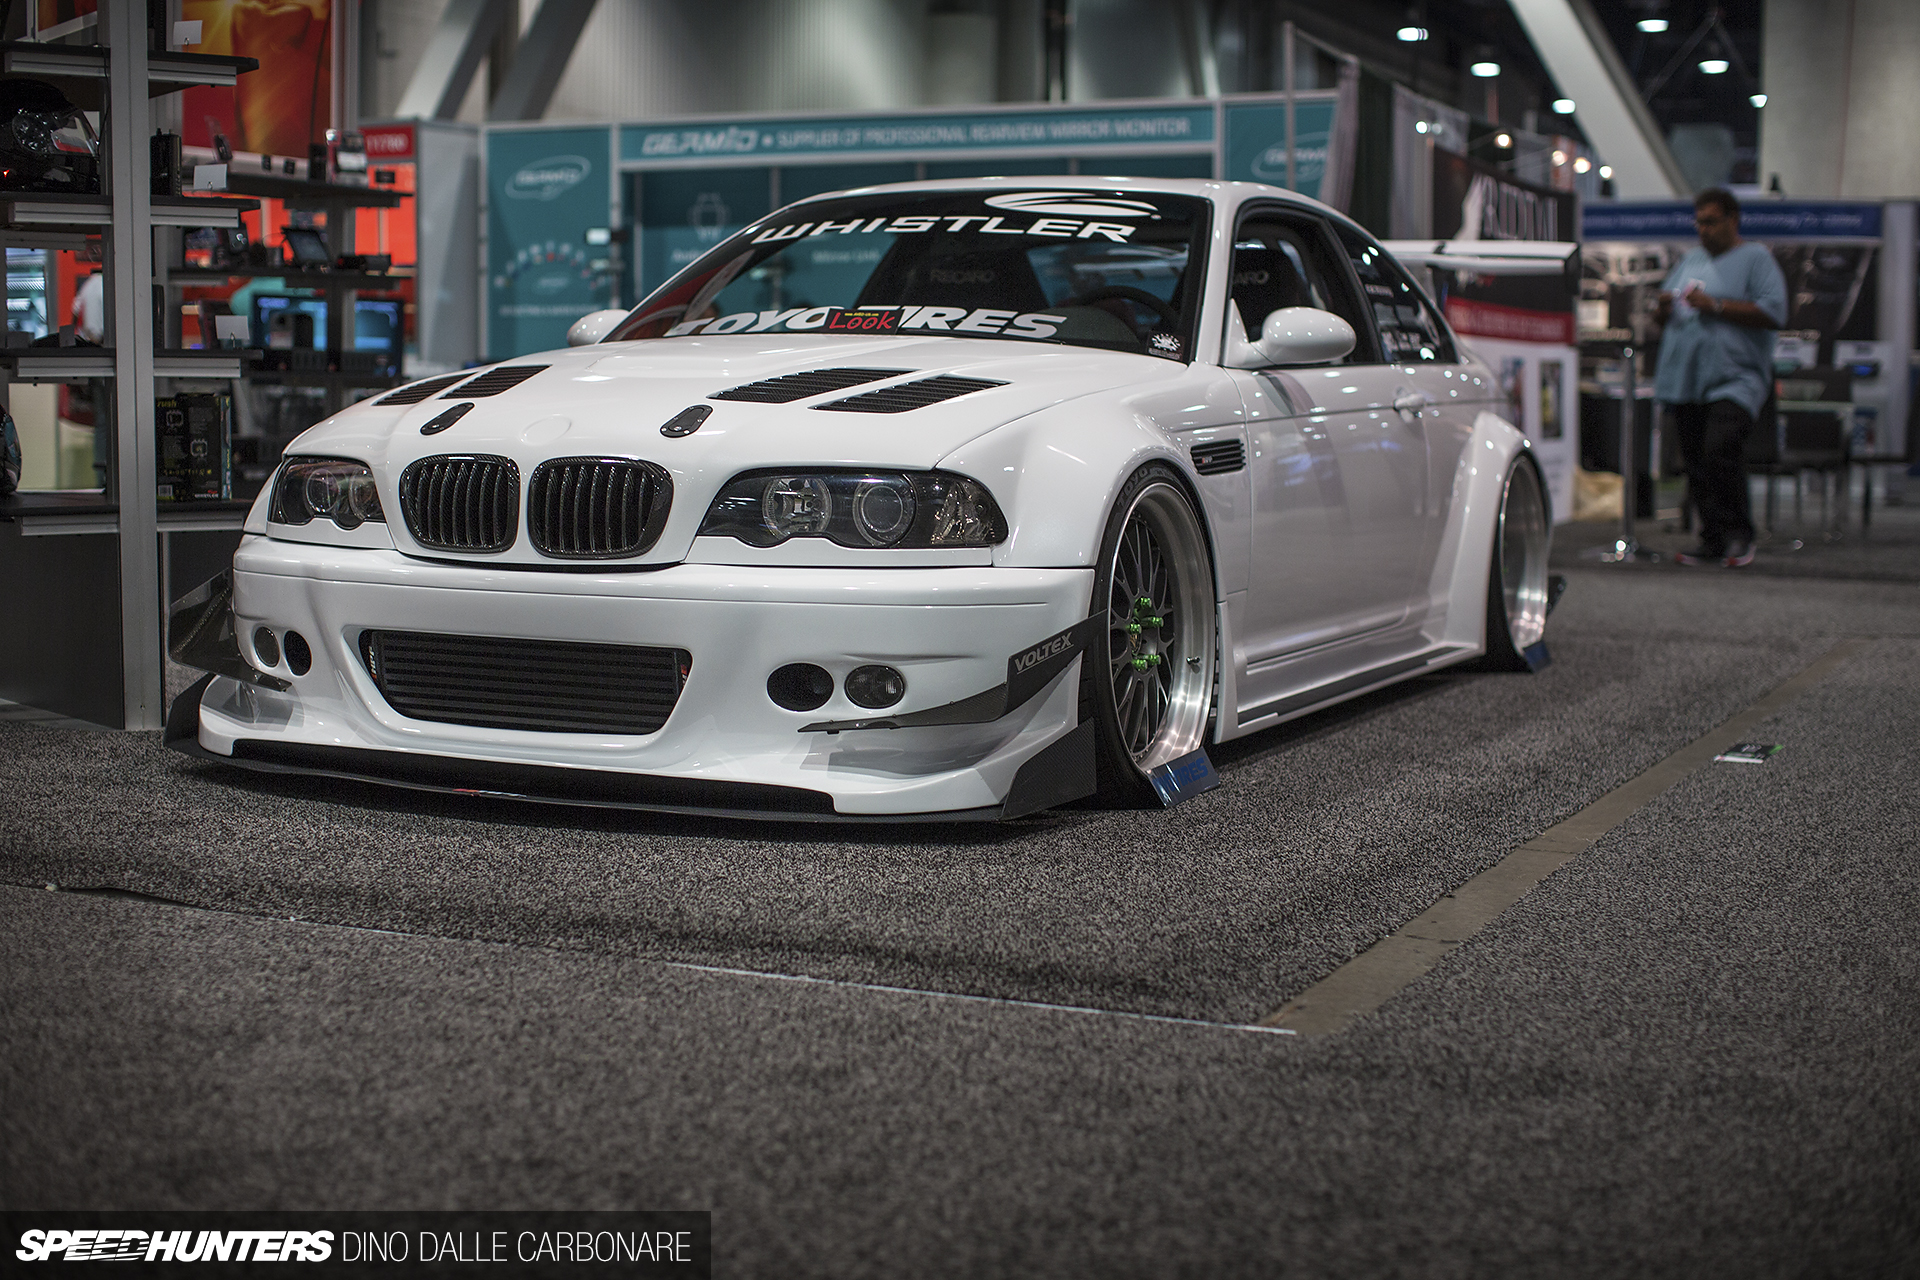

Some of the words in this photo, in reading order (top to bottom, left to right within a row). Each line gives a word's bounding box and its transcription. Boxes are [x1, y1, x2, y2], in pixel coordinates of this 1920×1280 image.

[751, 216, 1136, 244] WHISTLER
[663, 306, 844, 337] TOYO
[829, 311, 895, 330] Look
[1014, 631, 1072, 672] VOLTEX
